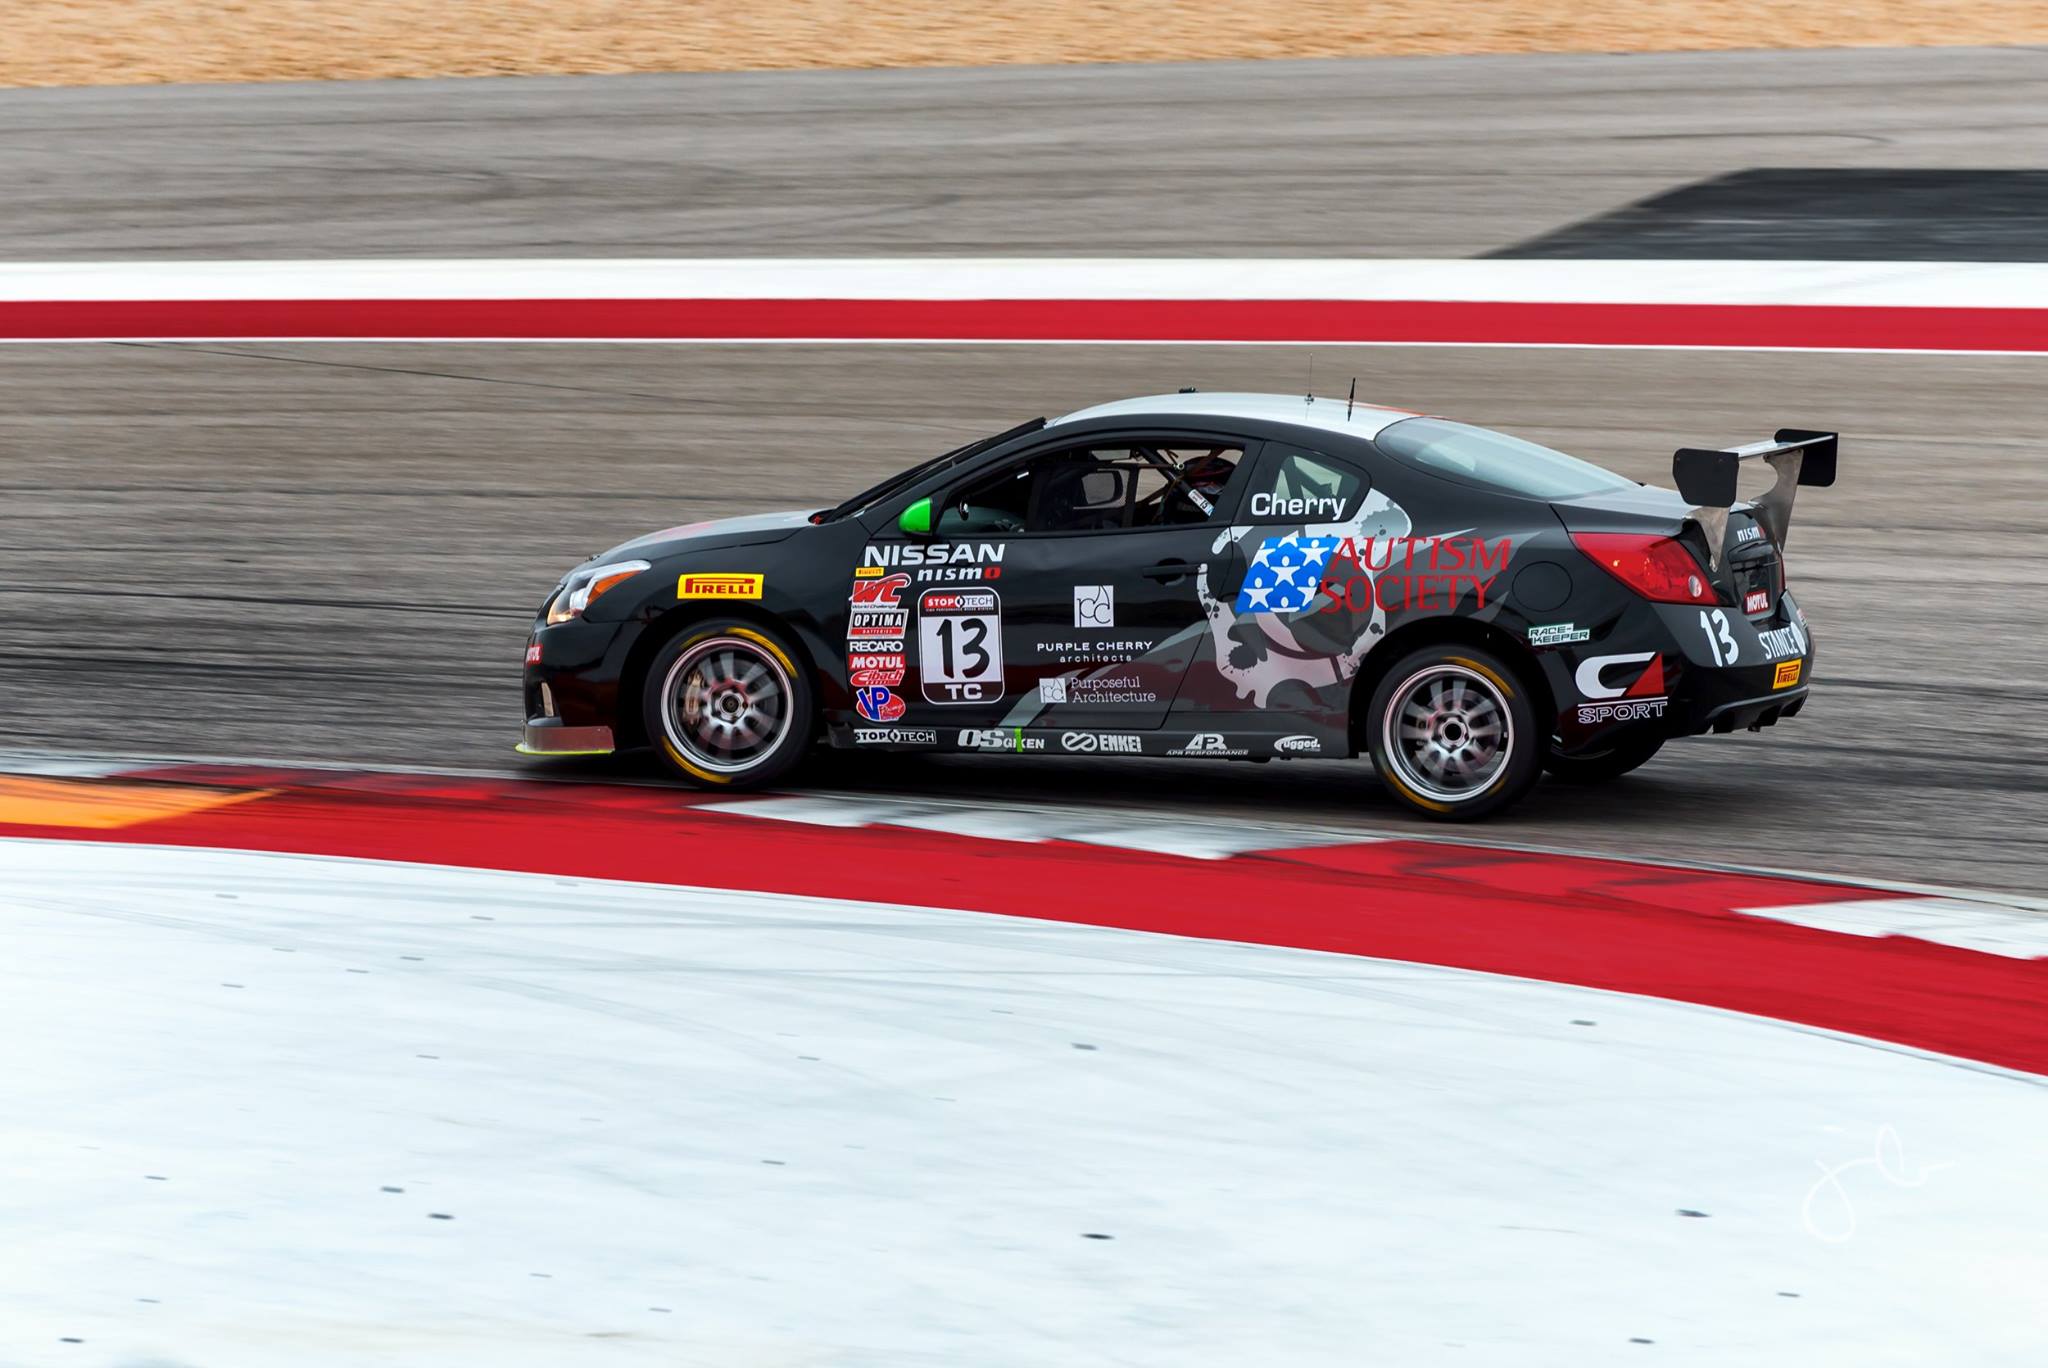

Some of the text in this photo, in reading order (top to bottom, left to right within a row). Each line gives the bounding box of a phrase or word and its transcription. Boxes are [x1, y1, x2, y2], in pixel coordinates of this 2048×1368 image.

[1250, 492, 1347, 521] Cherry
[863, 543, 1006, 568] NISSAN
[1329, 536, 1513, 572] AUTISM
[917, 567, 1002, 582] nismo
[685, 577, 756, 595] PIRELLI
[1319, 574, 1497, 614] SOCIETY
[1746, 592, 1768, 613] MOTUL
[853, 613, 903, 627] OPTIMA
[849, 641, 904, 652] RECARO
[1036, 640, 1153, 652] PURPLE CHERRY
[1533, 631, 1589, 645] KEEPER
[1700, 609, 1739, 667] 13
[935, 617, 990, 679] 13
[851, 656, 904, 669] MOTUL
[1059, 653, 1132, 663] architects
[1070, 676, 1141, 691] Purposeful
[1776, 665, 1798, 684] PIRELLI
[944, 683, 983, 700] TC
[1071, 690, 1157, 704] Architecture
[856, 685, 890, 720] VP
[1577, 701, 1668, 724] SPORT
[957, 729, 1005, 748] OS
[1099, 734, 1142, 753] ENKEI
